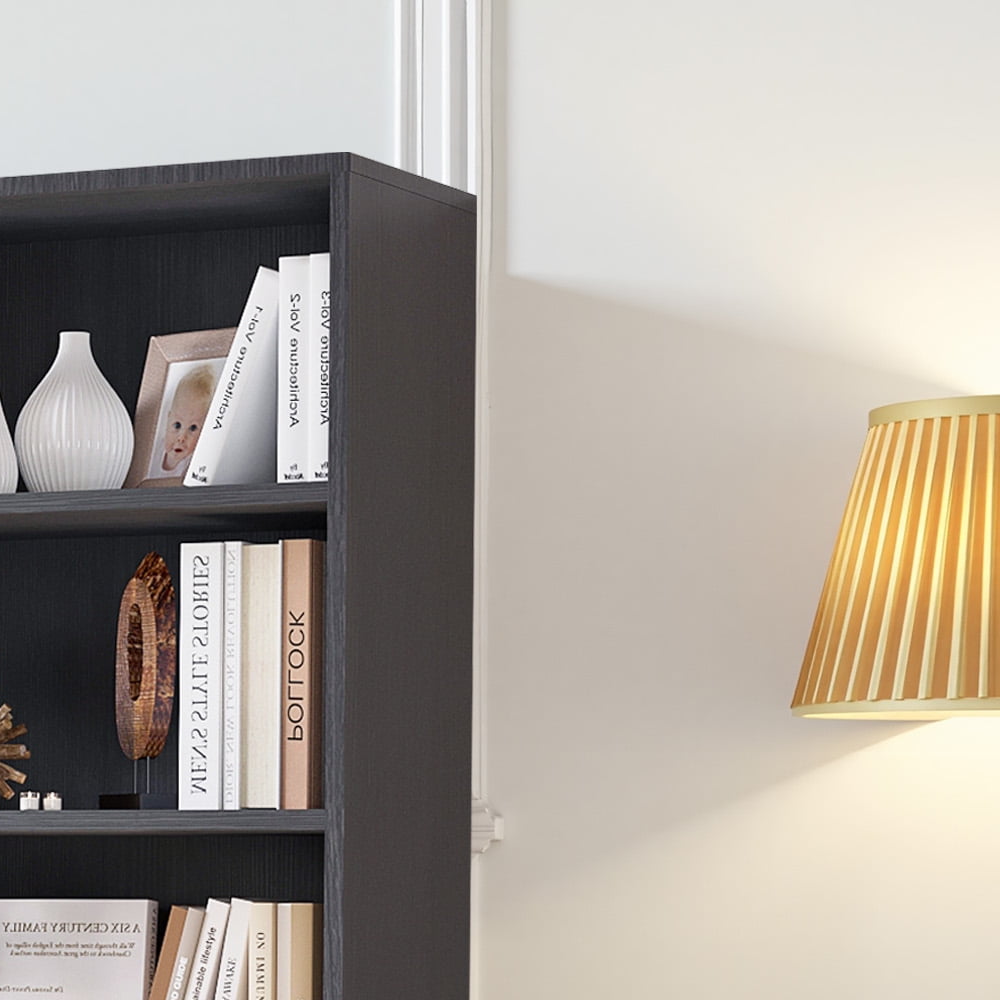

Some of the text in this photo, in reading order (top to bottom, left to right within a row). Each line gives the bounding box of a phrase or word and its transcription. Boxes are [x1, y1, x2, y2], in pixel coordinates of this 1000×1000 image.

[200, 926, 217, 966] lifestyle
[257, 932, 266, 950] ON
[175, 956, 188, 990] GUIDE
[224, 958, 238, 995] AWAKE
